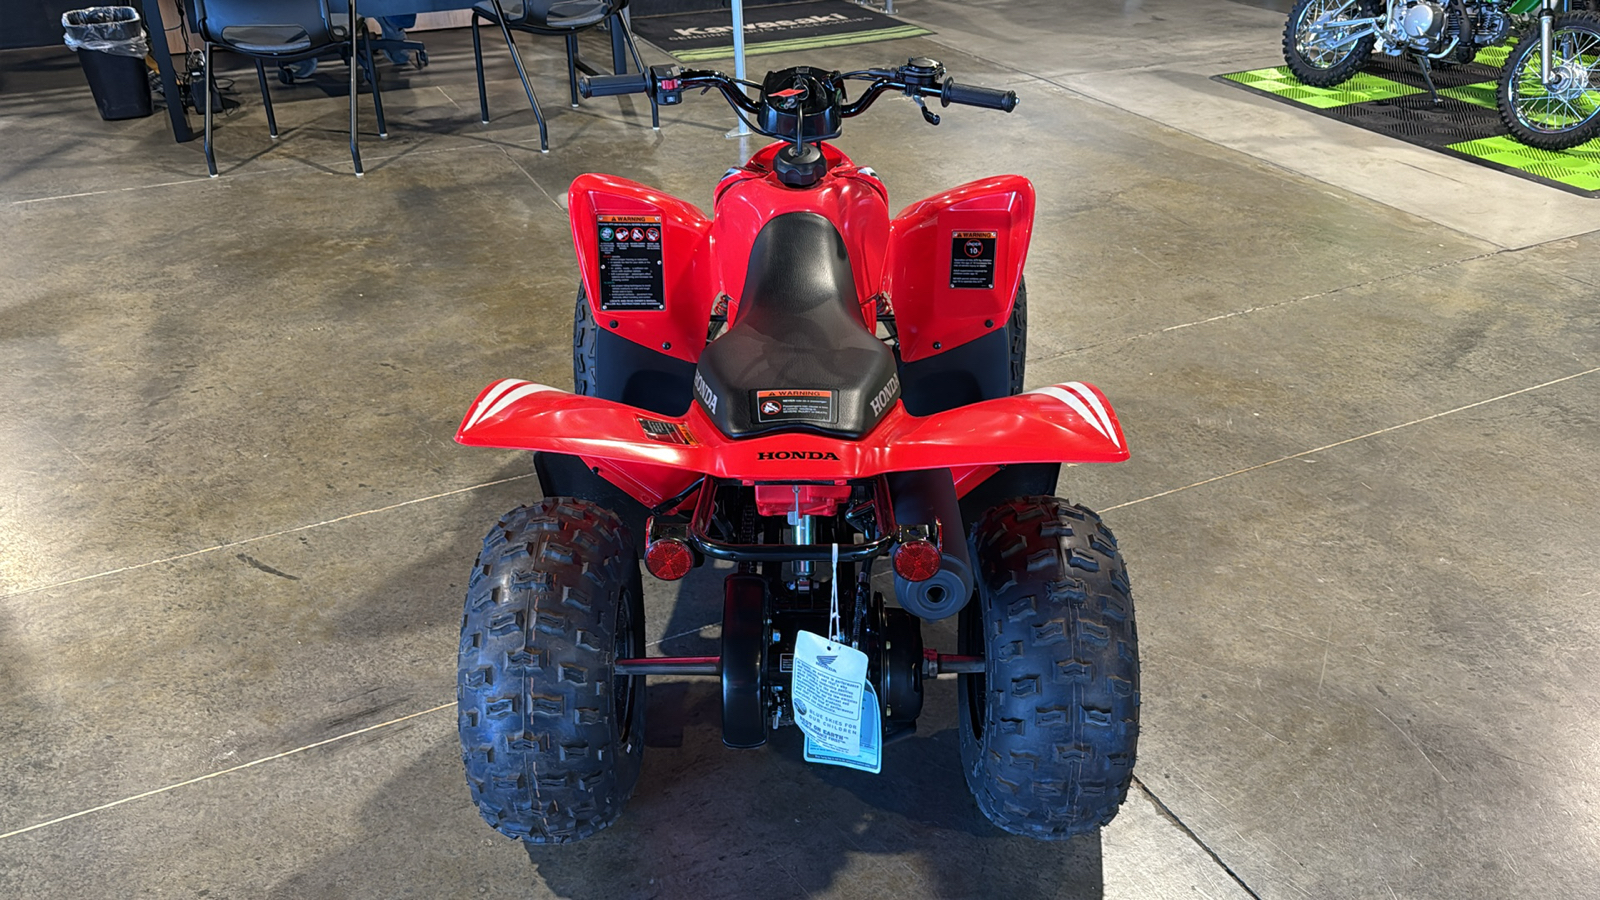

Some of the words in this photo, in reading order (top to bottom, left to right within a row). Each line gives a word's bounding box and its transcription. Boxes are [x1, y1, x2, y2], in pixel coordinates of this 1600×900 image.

[673, 12, 849, 36] Kawasaki
[694, 368, 718, 415] HONDA
[870, 372, 900, 417] HONDA
[757, 451, 840, 461] HONDA
[808, 714, 820, 723] OUR
[823, 721, 857, 735] CHILDREN
[809, 709, 823, 719] BLUE
[825, 716, 842, 726] SKIES
